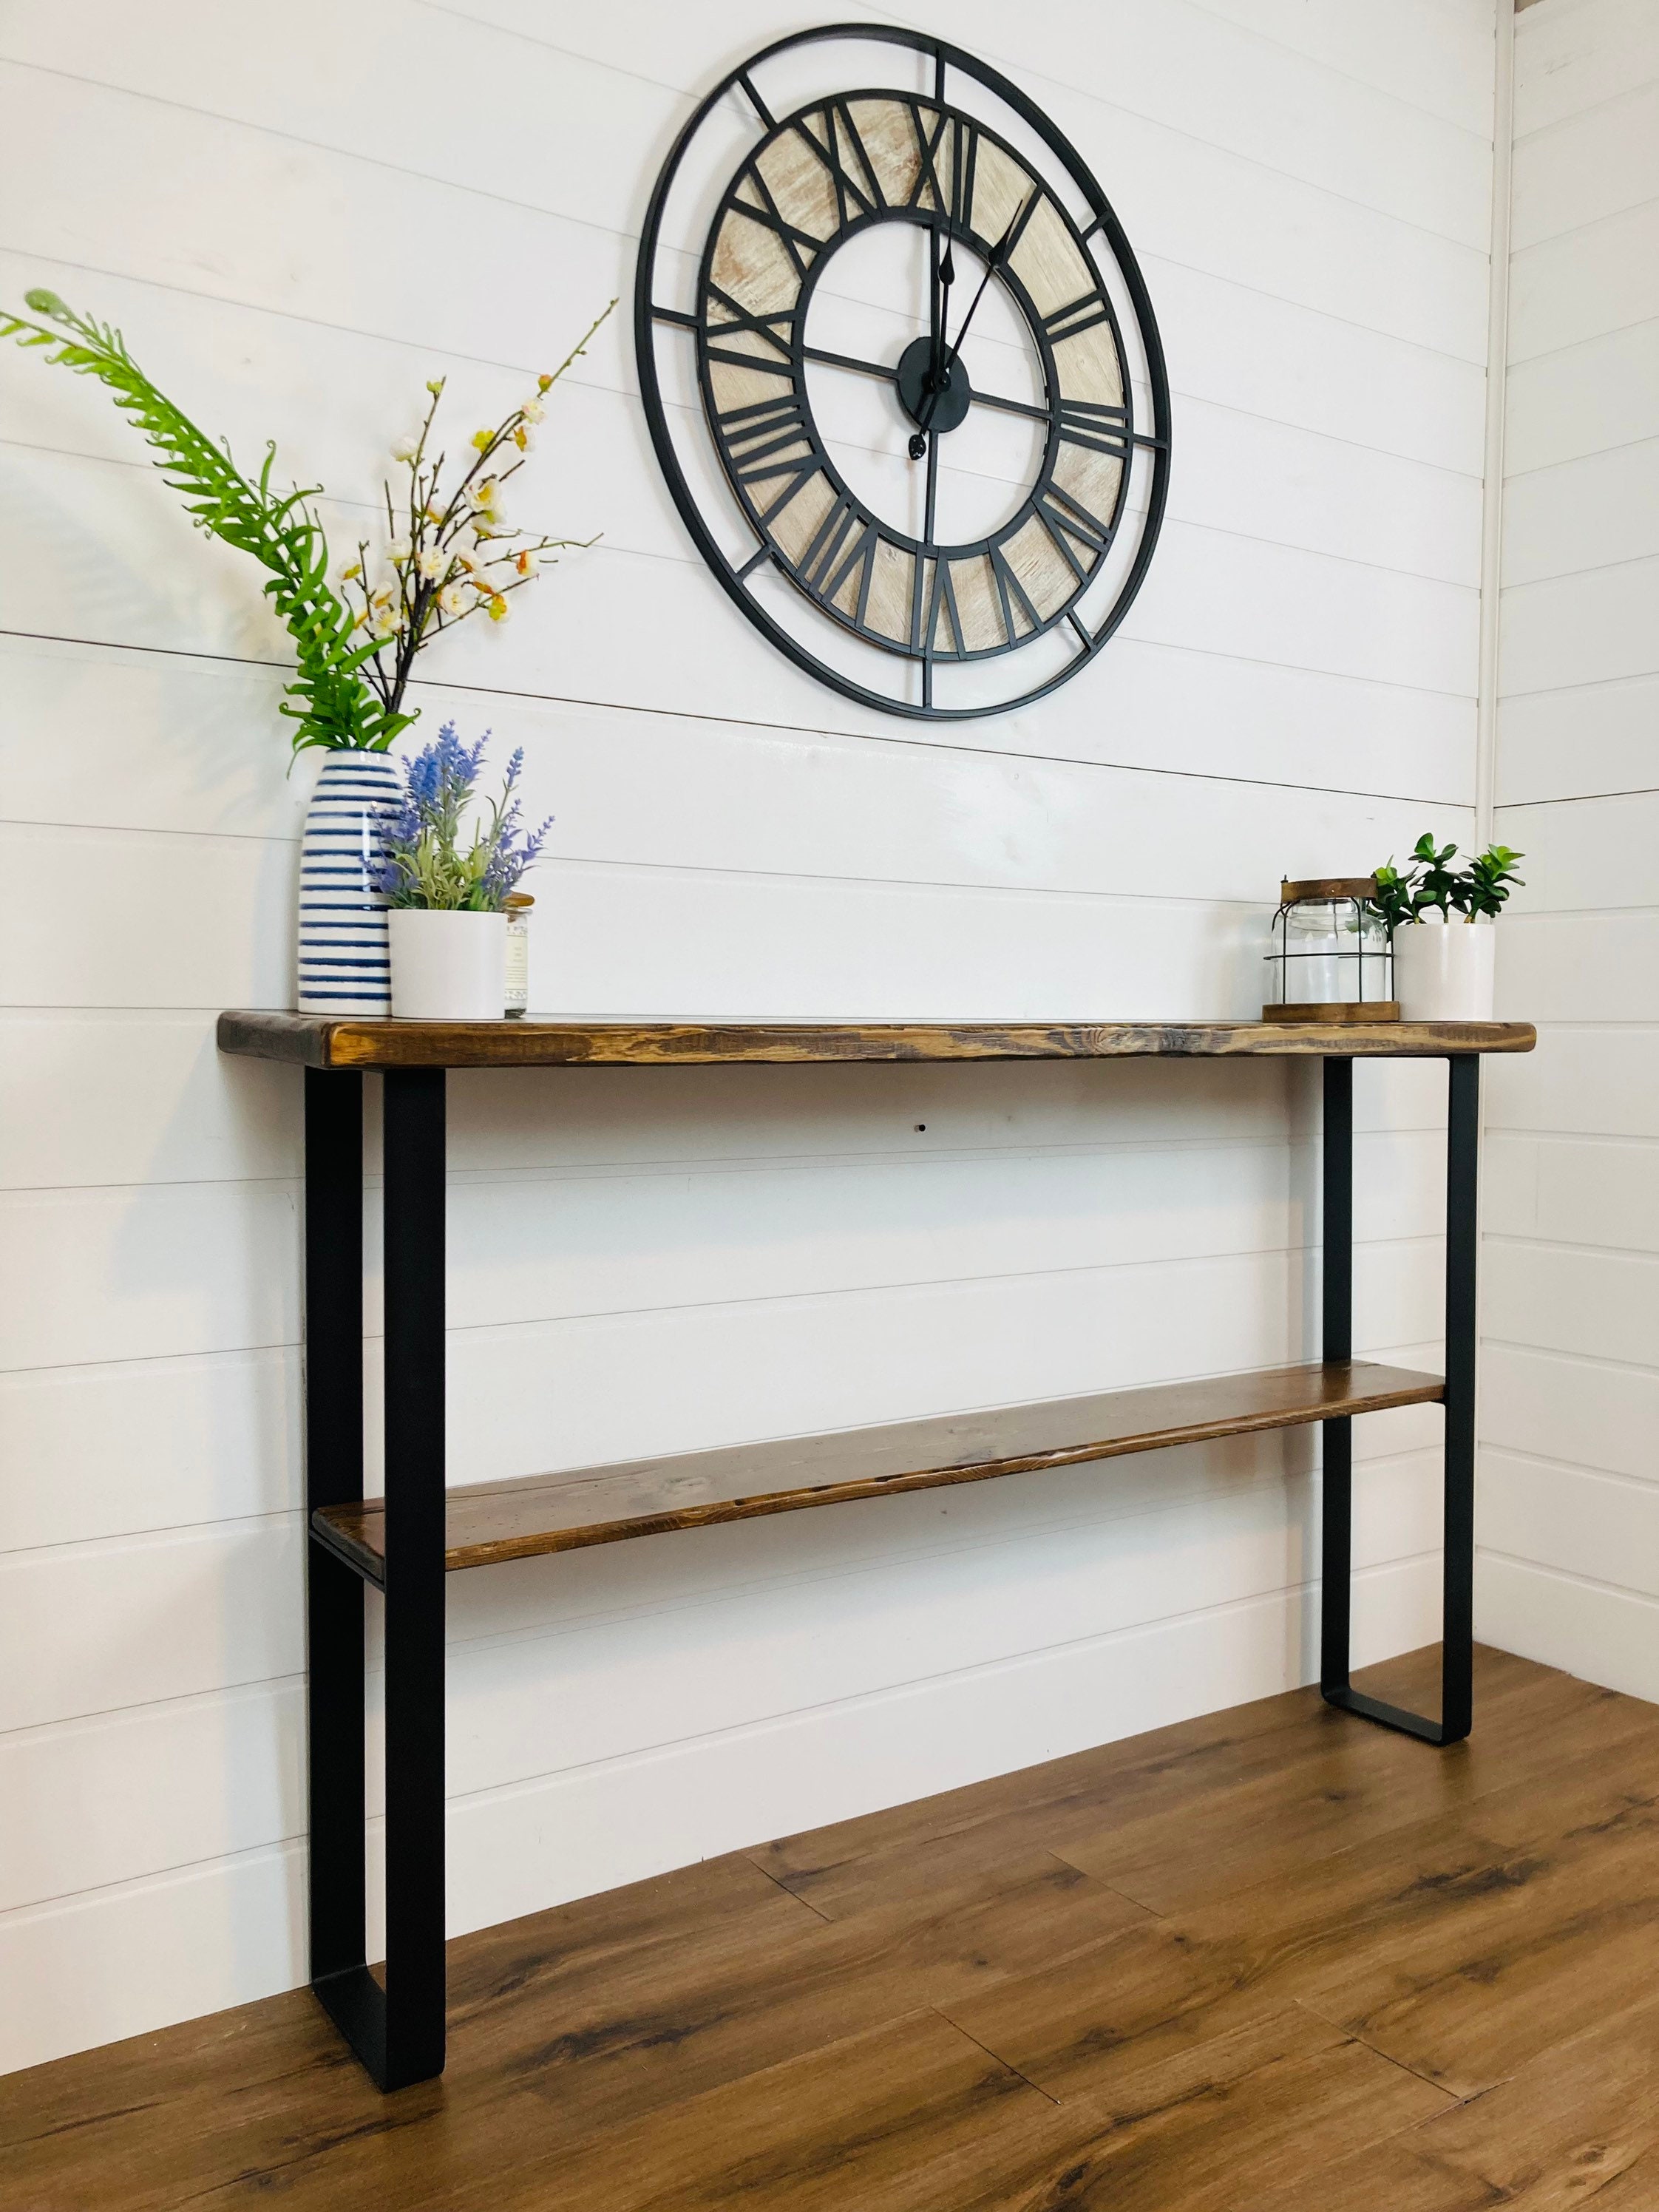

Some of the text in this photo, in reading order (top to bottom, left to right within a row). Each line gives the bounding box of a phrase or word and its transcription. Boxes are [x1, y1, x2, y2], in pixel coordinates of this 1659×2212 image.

[791, 97, 887, 232] XI
[906, 97, 979, 229] XII
[727, 163, 828, 288] X
[1038, 288, 1110, 347] II
[1053, 398, 1131, 458] III
[988, 540, 1045, 649] V
